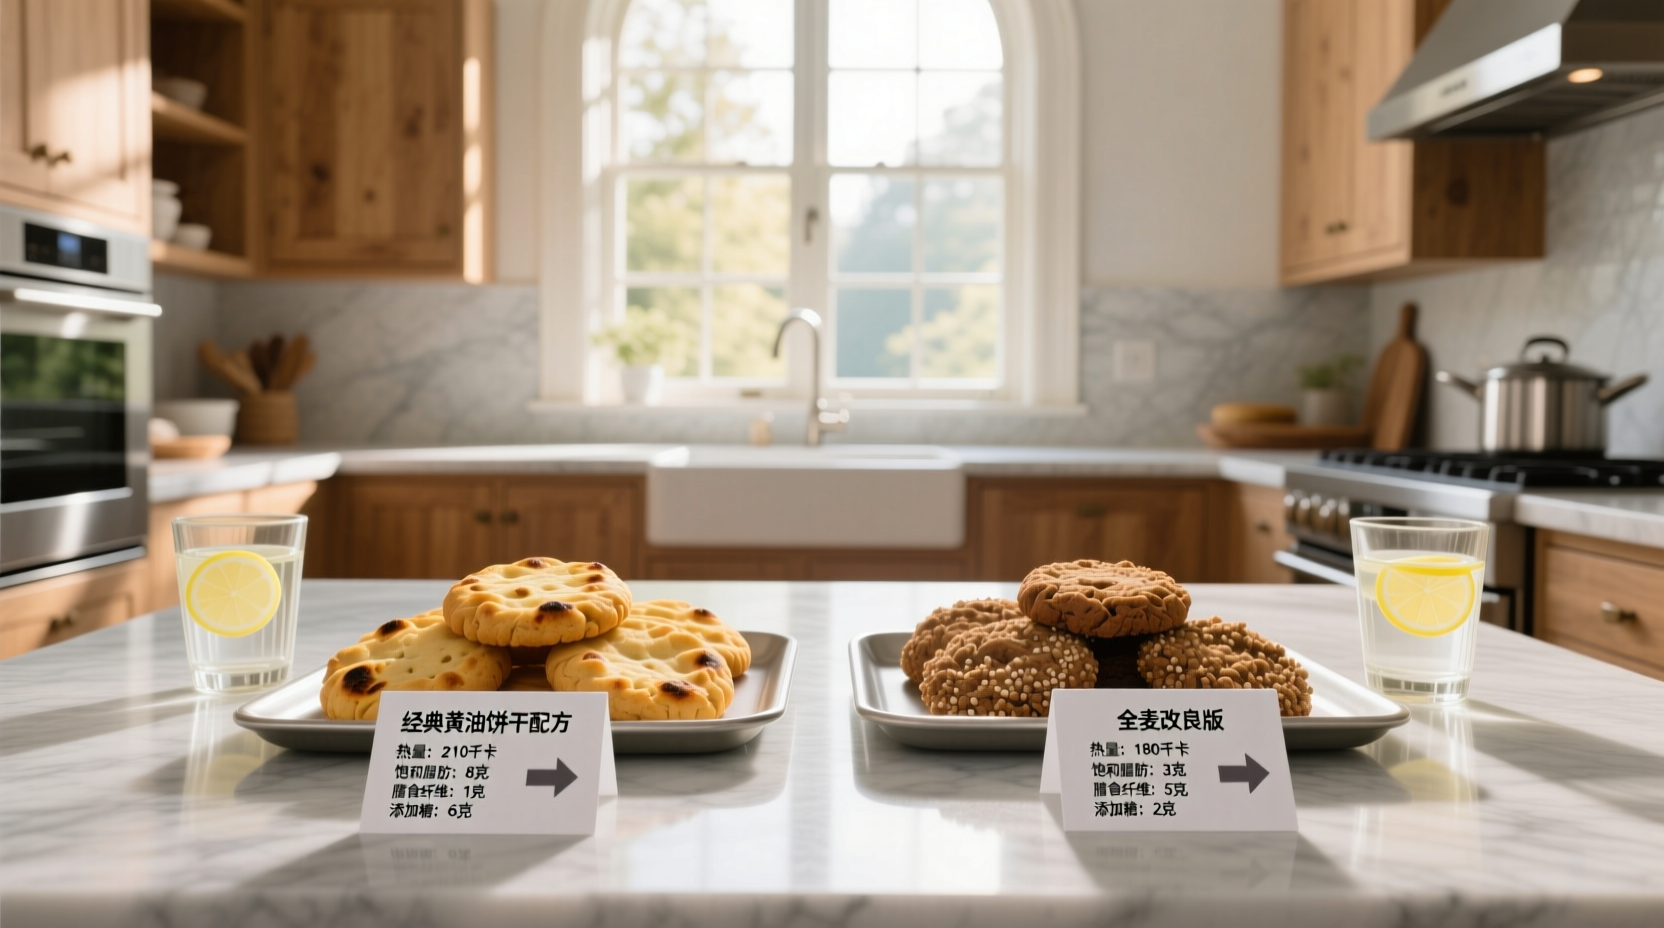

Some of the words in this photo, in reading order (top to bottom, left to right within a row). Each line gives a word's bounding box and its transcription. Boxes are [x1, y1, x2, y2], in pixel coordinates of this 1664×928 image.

[400, 709, 574, 735] 经典黄油饼干配方
[1116, 708, 1226, 732] 全麦改良版
